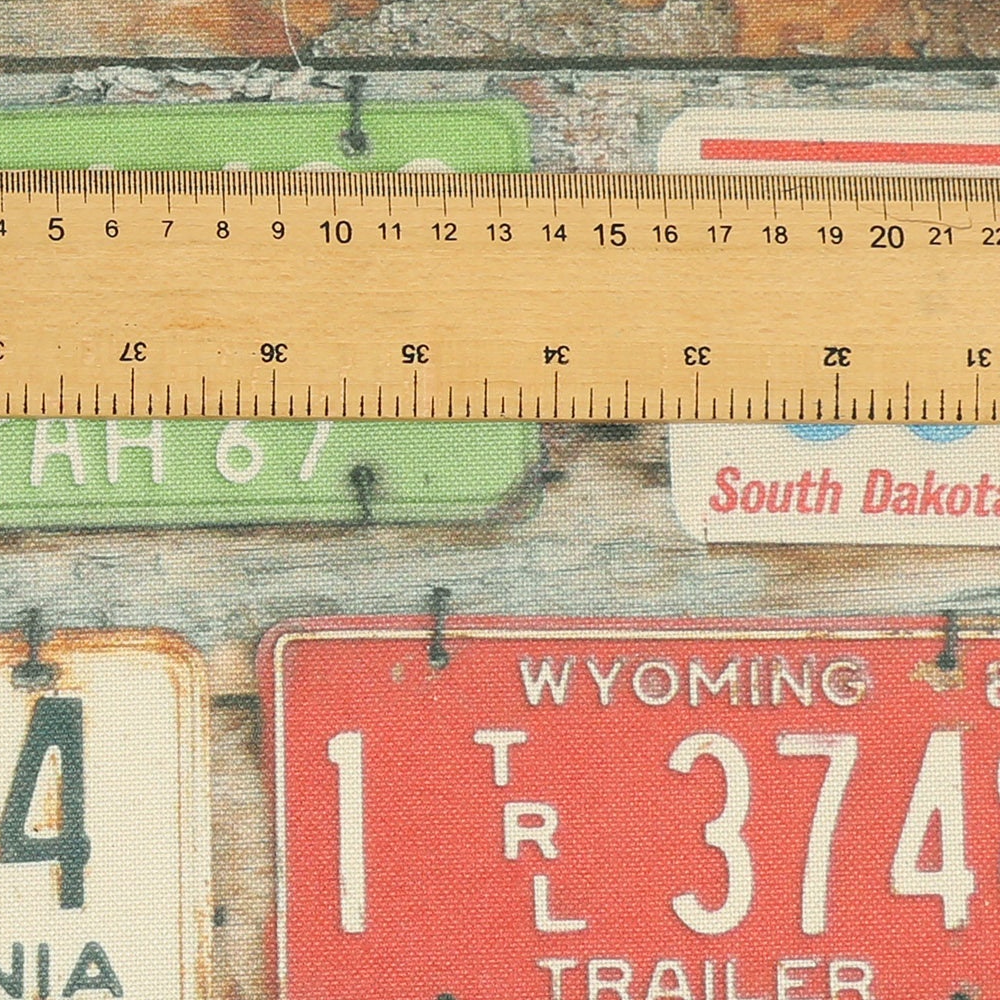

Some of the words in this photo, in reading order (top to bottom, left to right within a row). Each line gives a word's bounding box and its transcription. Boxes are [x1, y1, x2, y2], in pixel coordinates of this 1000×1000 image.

[48, 217, 66, 242] 5
[105, 219, 119, 238] 6
[161, 220, 174, 238] 7
[216, 220, 230, 239] 8
[271, 221, 285, 240] 9
[320, 220, 353, 244] 10
[378, 222, 401, 240] 11
[432, 222, 458, 241] 12
[486, 223, 513, 242] 13
[543, 224, 568, 242] 14
[593, 223, 627, 247] 15
[652, 224, 679, 244] 16
[707, 225, 733, 243] 17
[762, 225, 788, 245] 18
[817, 226, 843, 245] 19
[869, 225, 905, 249] 20
[928, 226, 953, 245] 21
[118, 341, 147, 362] 37
[260, 342, 288, 363] 36
[401, 344, 430, 364] 35
[543, 345, 570, 365] 34
[683, 346, 711, 366] 33
[823, 346, 852, 367] 32
[967, 347, 992, 368] 31
[708, 465, 844, 514] South
[860, 468, 1000, 517] Dakot
[519, 656, 873, 707] WYOMING
[327, 729, 367, 934] 1
[536, 957, 876, 1000] TRAILER
